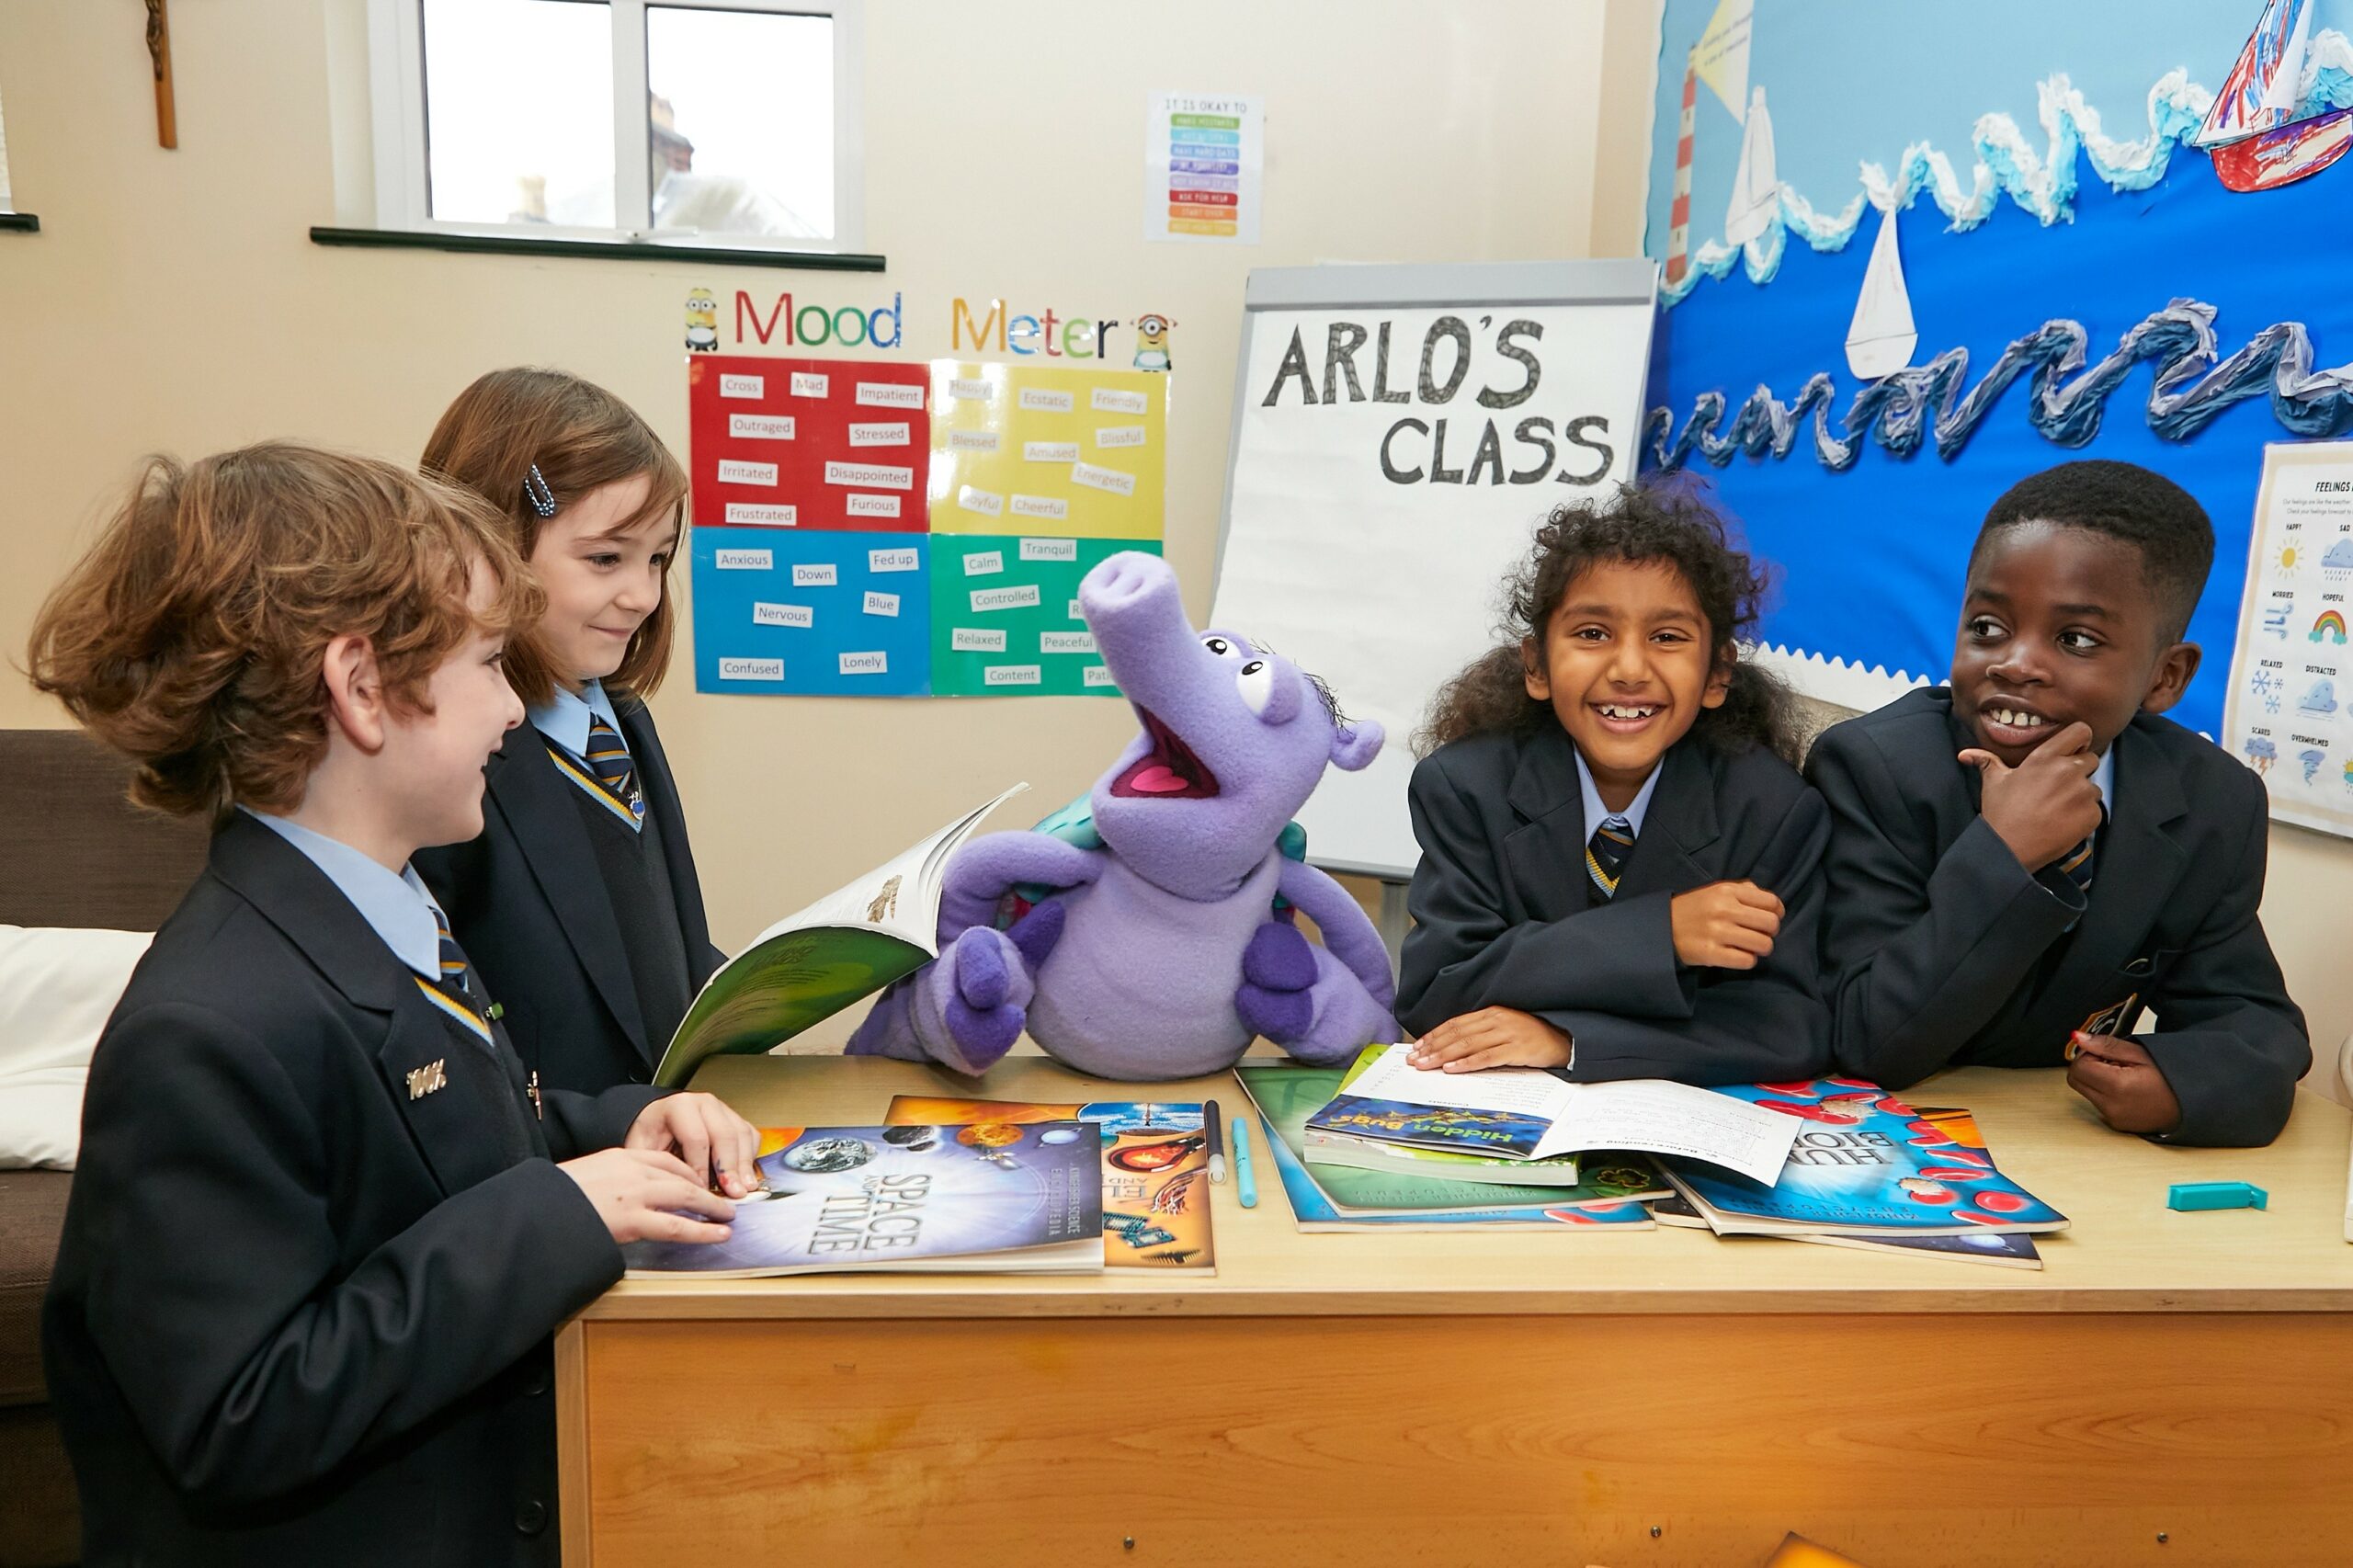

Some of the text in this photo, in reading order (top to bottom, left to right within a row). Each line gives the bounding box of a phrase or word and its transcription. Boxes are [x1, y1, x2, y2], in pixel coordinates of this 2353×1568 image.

[1166, 99, 1247, 114] IT IS OKAY TO
[736, 290, 1118, 358] Mood Meter
[1261, 314, 1544, 410] ARLO'S
[725, 379, 758, 392] Cross
[795, 379, 824, 392] Mad
[860, 387, 918, 403] Impatient
[1023, 392, 1069, 408] Ecstatic
[1096, 392, 1142, 411] Friendly
[733, 418, 790, 435] Outraged
[854, 427, 904, 440] Stressed
[951, 434, 997, 449] Blessed
[1100, 431, 1142, 445] Blissful
[1028, 446, 1076, 459] Amused
[1380, 415, 1614, 486] CLASS
[722, 465, 773, 480] Irritated
[830, 466, 908, 483] Disappointed
[1076, 467, 1130, 489] Energetic
[2315, 482, 2351, 492] FEELINGS
[851, 498, 895, 512] Furious
[1014, 498, 1064, 515] Cheerful
[730, 507, 792, 521] Frustrated
[2339, 524, 2351, 532] SAD
[1025, 542, 1074, 557] Tranquil
[721, 554, 768, 565] Anxious
[874, 553, 914, 567] Fed up
[969, 557, 998, 570] Calm
[797, 569, 832, 581] Down
[974, 589, 1036, 606] Controlled
[2272, 590, 2294, 599] WORRIED
[2322, 593, 2345, 602] HOPEFUL
[869, 597, 894, 610] Blue
[758, 607, 808, 621] Nervous
[956, 633, 1002, 645] Relaxed
[1044, 636, 1093, 648] Peaceful
[724, 662, 779, 675] Confused
[844, 656, 881, 670] Lonely
[2260, 659, 2283, 668] RELAXED
[989, 670, 1036, 681] Content
[2305, 665, 2337, 676] DISTRACTED
[2252, 727, 2271, 736] SCARED
[2291, 733, 2329, 747] OVERWHELMED
[1340, 1114, 1513, 1142] Hidden Bugs
[864, 1174, 934, 1251] SPACE
[809, 1189, 874, 1256] TIME
[1068, 1207, 1080, 1234] SCIENCE
